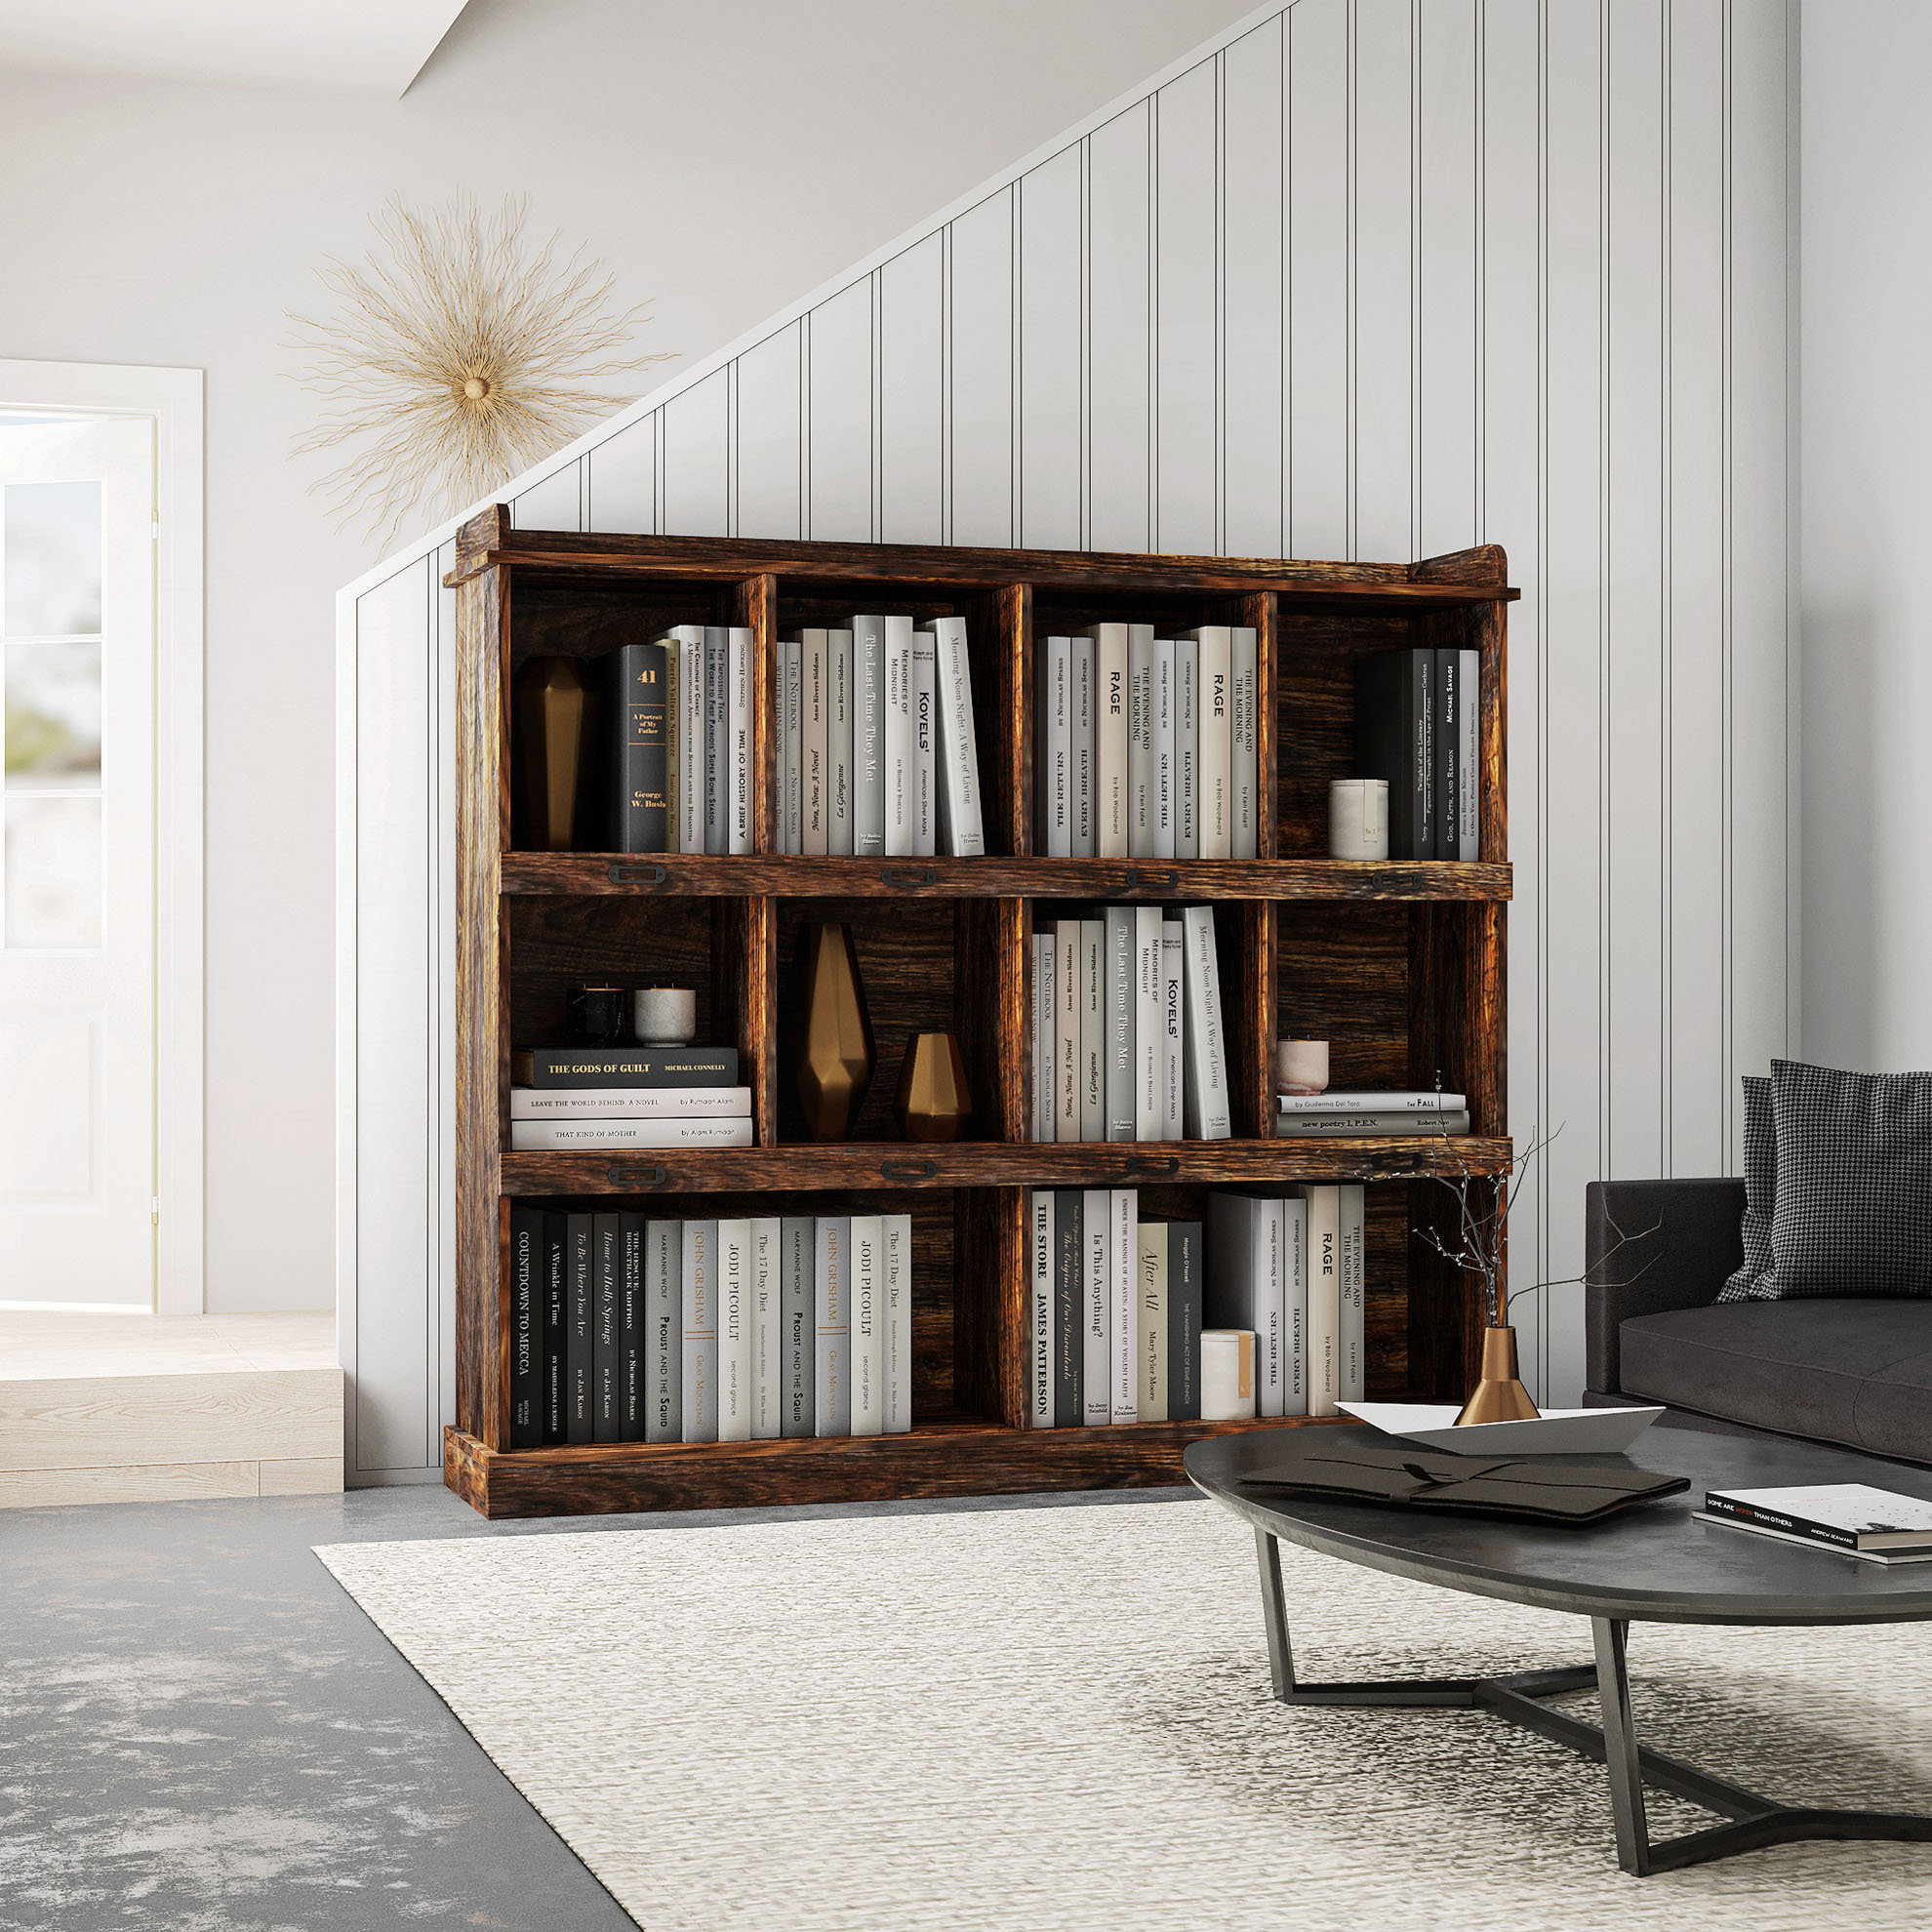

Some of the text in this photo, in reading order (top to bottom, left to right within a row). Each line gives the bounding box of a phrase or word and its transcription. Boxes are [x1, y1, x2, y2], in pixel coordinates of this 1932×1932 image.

[950, 637, 963, 675] Morning
[637, 670, 656, 683] 41
[953, 677, 963, 701] Noon
[1110, 672, 1120, 714] RAGE
[1214, 675, 1224, 716] RAGE
[864, 635, 876, 783] The Last Time They Met
[902, 703, 907, 715] OF
[919, 692, 929, 752] KOVELS'
[953, 704, 966, 733] Night:
[739, 752, 745, 764] OF
[957, 742, 970, 762] Way
[961, 764, 970, 774] of
[634, 790, 662, 799] George
[960, 776, 972, 805] Living
[1115, 926, 1128, 1069] The Last Time They Met
[1168, 980, 1178, 1038] KOVELS'
[572, 1065, 601, 1073] GODS
[578, 1233, 586, 1245] To
[578, 1247, 586, 1260] Be
[890, 1231, 899, 1250] The
[1323, 1233, 1333, 1274] RAGE
[890, 1254, 899, 1264] 17
[1038, 1235, 1047, 1278] STORE
[578, 1264, 586, 1295] Where
[601, 1232, 613, 1345] Home to Holly Springs
[694, 1231, 704, 1324] JOHN GRISHAM
[862, 1241, 871, 1337] JODI PICOULT
[889, 1267, 899, 1285] Day
[1092, 1234, 1104, 1338] Is This Anything?
[1142, 1248, 1159, 1310] After All
[519, 1231, 529, 1375] COUNTDOWN TO MECCA
[578, 1298, 586, 1314] You
[729, 1244, 739, 1341] JODI PICOULT
[660, 1316, 670, 1350] PROUST
[793, 1312, 803, 1347] PROUST
[1147, 1332, 1156, 1352] Mary
[1037, 1293, 1047, 1415] JAMES PATTERSON
[1147, 1353, 1156, 1375] Tyler
[660, 1398, 670, 1428] SQUID
[793, 1392, 803, 1422] SQUID
